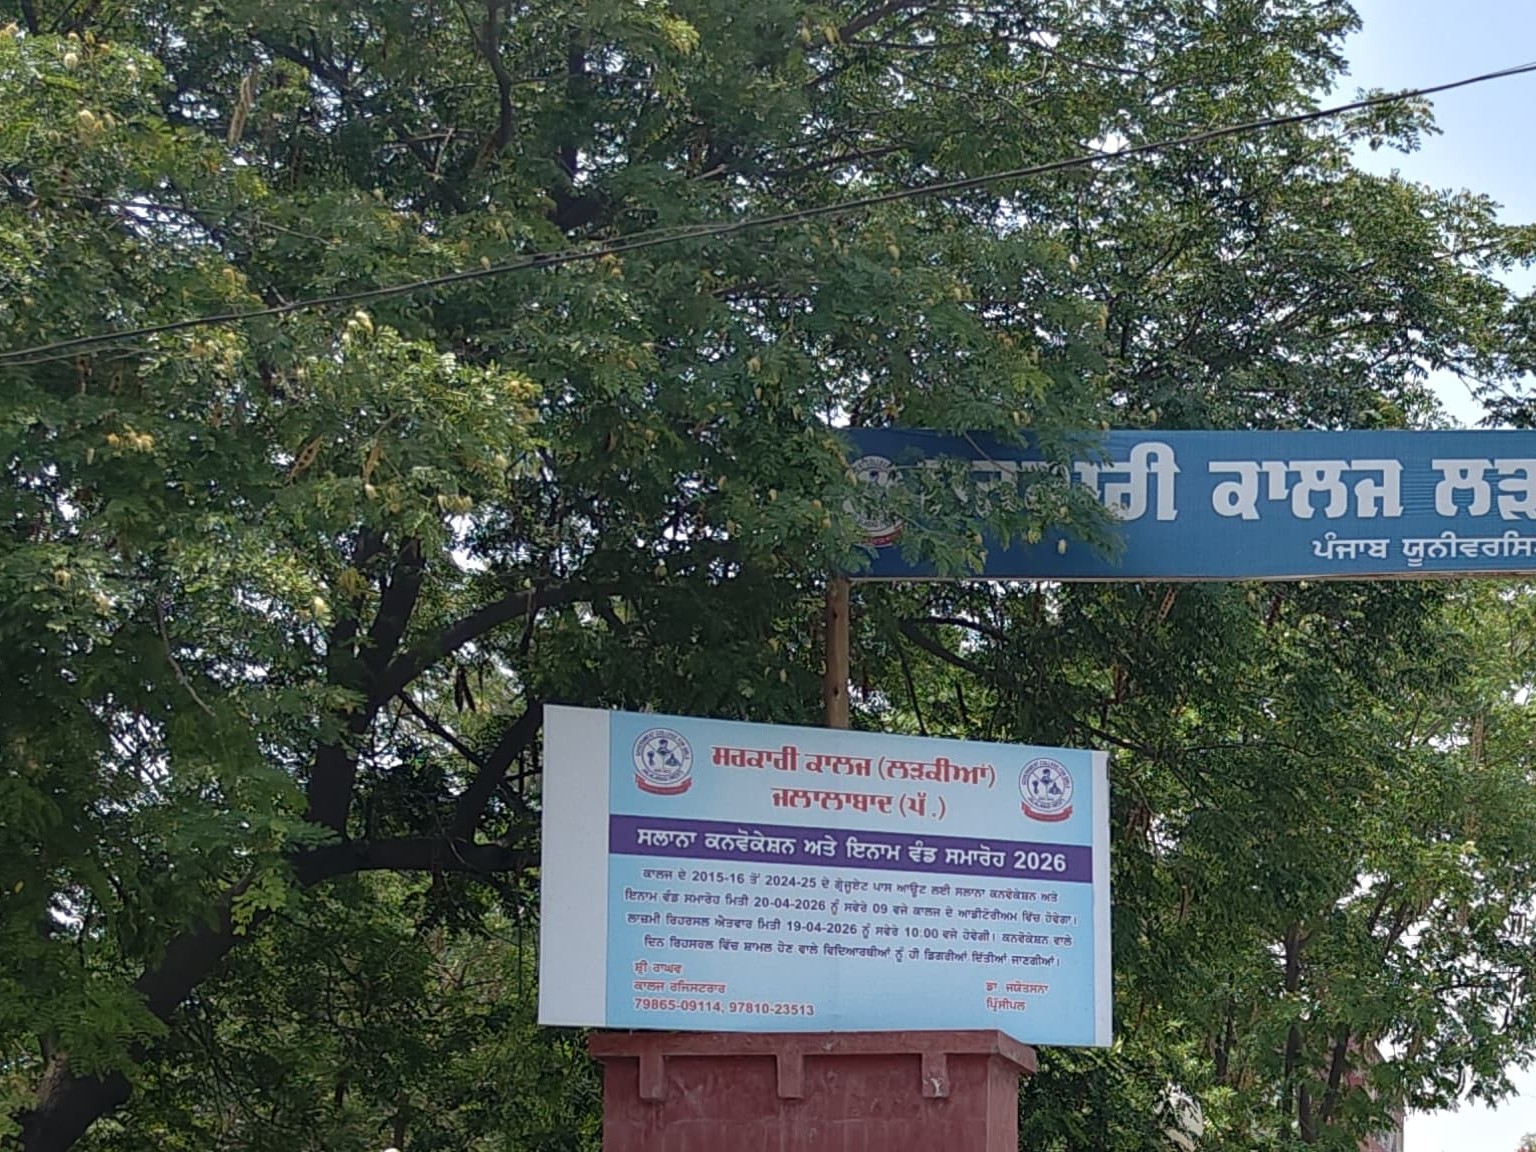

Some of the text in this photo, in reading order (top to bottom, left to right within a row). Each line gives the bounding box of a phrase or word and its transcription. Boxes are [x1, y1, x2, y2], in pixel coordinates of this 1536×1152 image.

[1208, 457, 1404, 520] ਕਾਲਜ
[1312, 530, 1389, 561] ਪੰਜਾਬ
[711, 745, 800, 771] ਸਰਕਾਰੀ
[804, 753, 873, 777] ਕਾਲਜ
[878, 755, 996, 788] (ਲੜਕੀਆਂ)
[771, 787, 894, 814] ਜਲਾਲਾਬਾਦ
[637, 827, 1066, 872] ਸਲਾਨਾ ਕਨਵੋਕੇਸ਼ਨ ਅਤੇ ਇਨਾਮ ਵੰਡ ਸਮਾਰੋਹ 2026
[642, 868, 673, 881] ਕਾਲਜ
[678, 866, 687, 881] ਦੇ
[692, 870, 745, 884] 2015-16
[765, 874, 817, 889] 2024-25
[821, 876, 830, 889] ਦੇ
[873, 882, 892, 893] ਪਾਸ
[931, 885, 951, 897] ਲਈ
[955, 887, 986, 899] ਸਲਾਨਾ
[1040, 890, 1059, 903] ਅਤੇ
[625, 887, 658, 902] ਇਨਾਮ
[684, 892, 720, 905] ਸਮਾਰੋਹ
[725, 893, 750, 907] ਮਿਤੀ
[754, 896, 826, 911] 20-04-2026
[844, 900, 868, 914] ਸਵੇਰੇ
[872, 902, 888, 914] 09
[892, 902, 908, 916] ਵਜੇ
[913, 905, 941, 918] ਕਾਲਜ
[945, 905, 953, 918] ਦੇ
[714, 914, 753, 930] ਐਤਵਾਰ
[757, 917, 781, 931] ਮਿਤੀ
[787, 920, 858, 935] 19-04-2026
[875, 924, 899, 938] ਸਵੇਰੇ
[904, 927, 939, 940] 10:00
[942, 926, 959, 940] ਵਜੇ
[1053, 933, 1073, 947] ਵਾਲੇ
[644, 934, 665, 948] ਦਿਨ
[777, 940, 794, 954] ਹੋਣ
[798, 942, 818, 956] ਵਾਲੇ
[908, 947, 920, 960] ਹੀ
[633, 980, 666, 992] ਕਾਲਜ
[729, 1001, 815, 1017] 97810-23513
